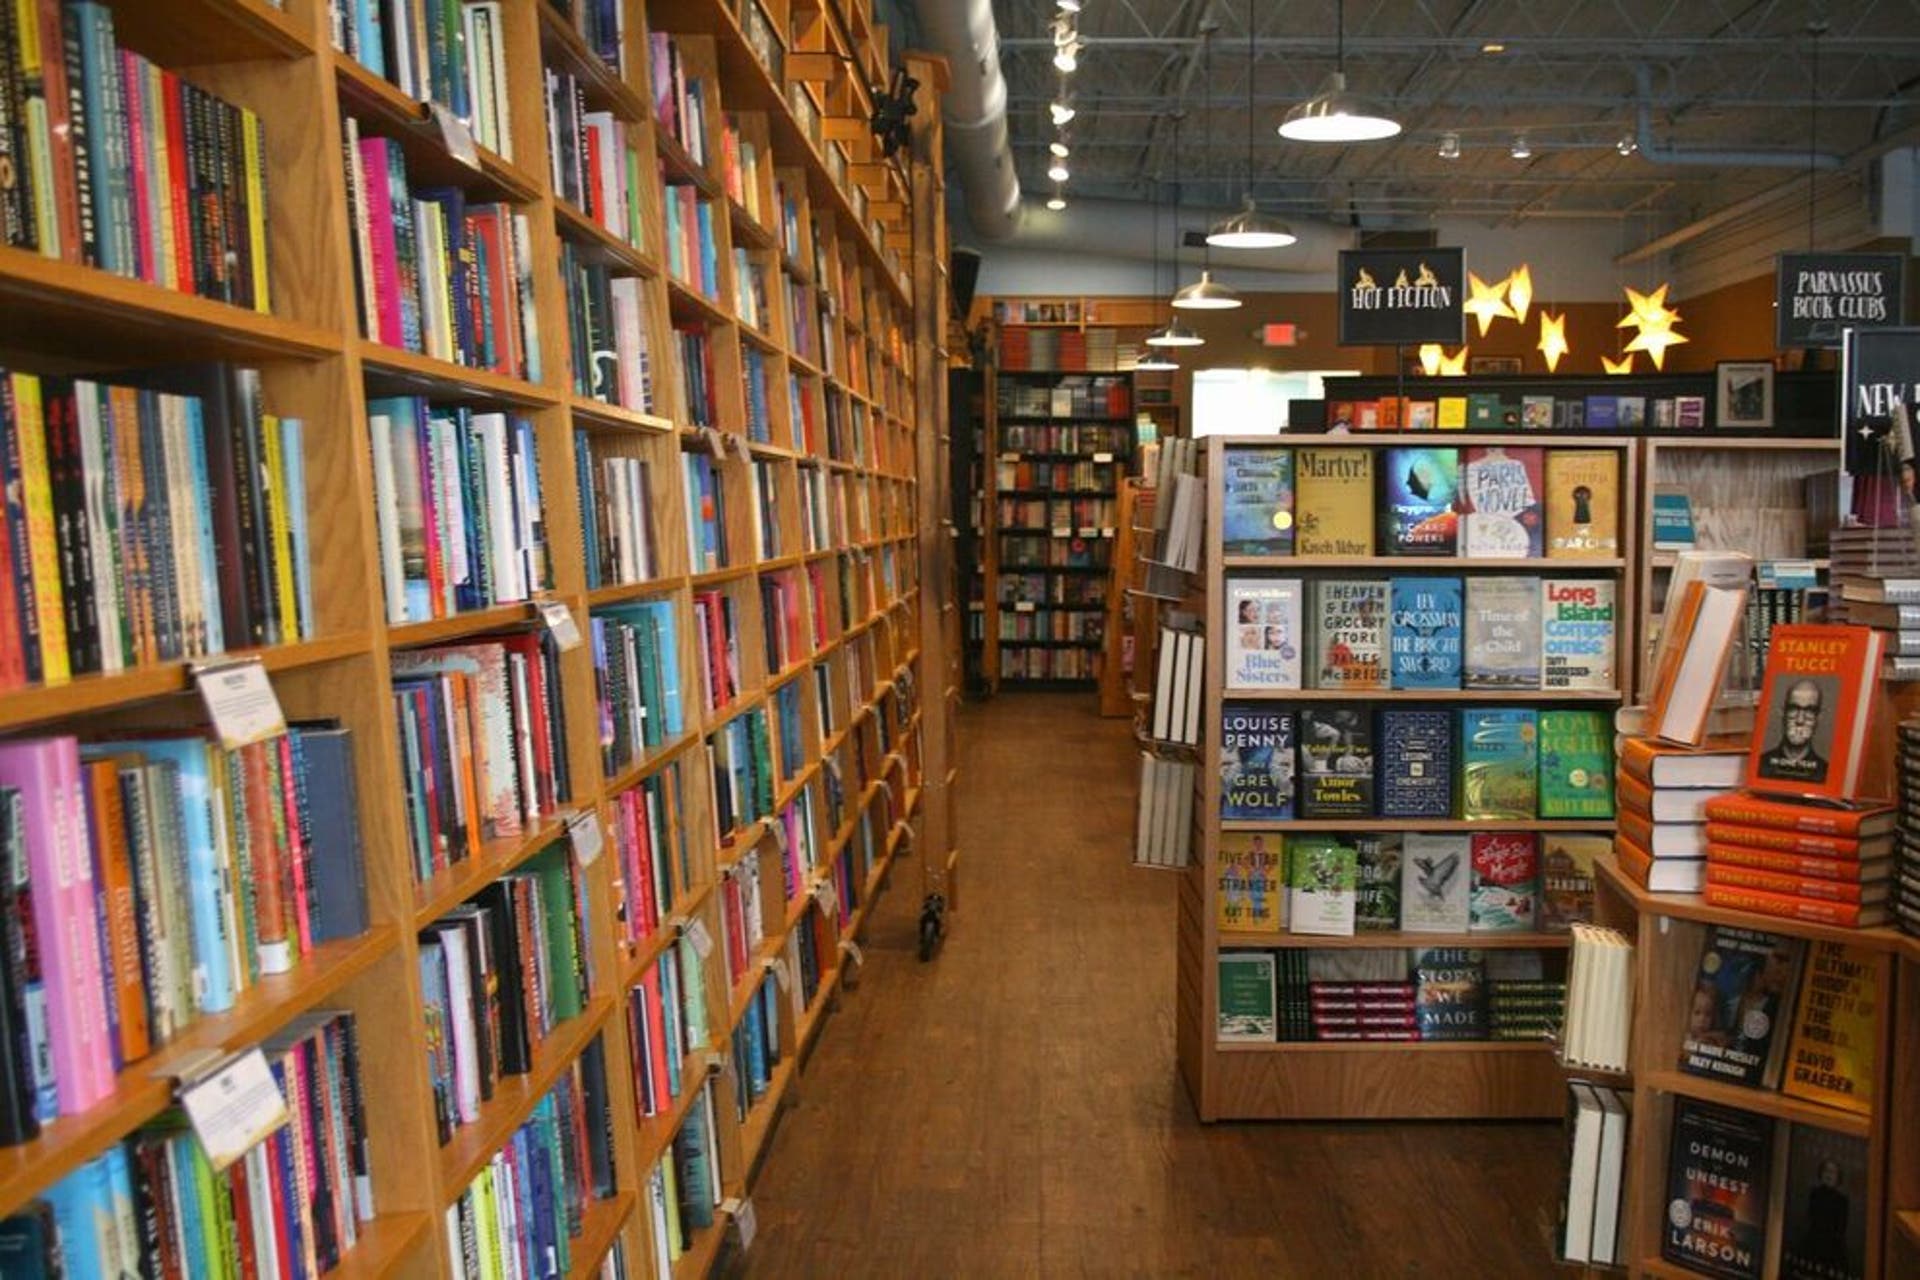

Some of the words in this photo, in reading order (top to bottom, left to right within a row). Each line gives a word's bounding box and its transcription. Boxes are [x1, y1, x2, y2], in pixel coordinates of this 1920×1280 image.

[70, 87, 85, 137] KATE
[75, 145, 94, 244] ATKINSON
[1797, 271, 1883, 295] PARNASSUS
[1352, 287, 1383, 310] HOT
[1387, 286, 1452, 310] FICTION
[1793, 296, 1835, 319] BOOK
[1838, 296, 1887, 320] CLUBS
[1857, 383, 1905, 418] NEW
[1300, 453, 1368, 482] Martyr!
[1477, 465, 1526, 488] PARIS
[1477, 488, 1530, 513] NOVEL
[1398, 533, 1445, 543] POWERS
[1333, 586, 1385, 599] HEAVEN
[1548, 584, 1597, 606] Long
[1326, 602, 1337, 614] &
[1341, 601, 1385, 614] EARTH
[1557, 603, 1613, 621] Island
[1324, 616, 1386, 630] GROCERY
[1393, 611, 1459, 627] GROSSMAN
[1479, 610, 1510, 623] Time
[1333, 631, 1378, 643] STORE
[1415, 636, 1459, 653] BRIGHT
[1486, 640, 1521, 653] Child
[1546, 639, 1604, 654] omise
[1778, 640, 1848, 654] STANLEY
[1245, 653, 1281, 669] Blue
[1332, 653, 1381, 665] JAMES
[1400, 656, 1451, 673] SWORD
[1786, 658, 1836, 671] TUCCI
[1236, 668, 1290, 684] Sisters
[1321, 669, 1388, 681] McBRIDE
[1224, 716, 1291, 731] LOUISE
[1225, 734, 1288, 748] PENNY
[1234, 775, 1280, 787] GREY
[1226, 792, 1288, 808] WOLF
[116, 886, 136, 986] DAUGHTER
[1434, 949, 1467, 963] THE
[1424, 1011, 1477, 1025] MADE
[1690, 1141, 1749, 1168] DEMON
[1686, 1167, 1749, 1195] UNREST
[1693, 1216, 1732, 1238] ERIK
[1671, 1230, 1750, 1267] LARSON
